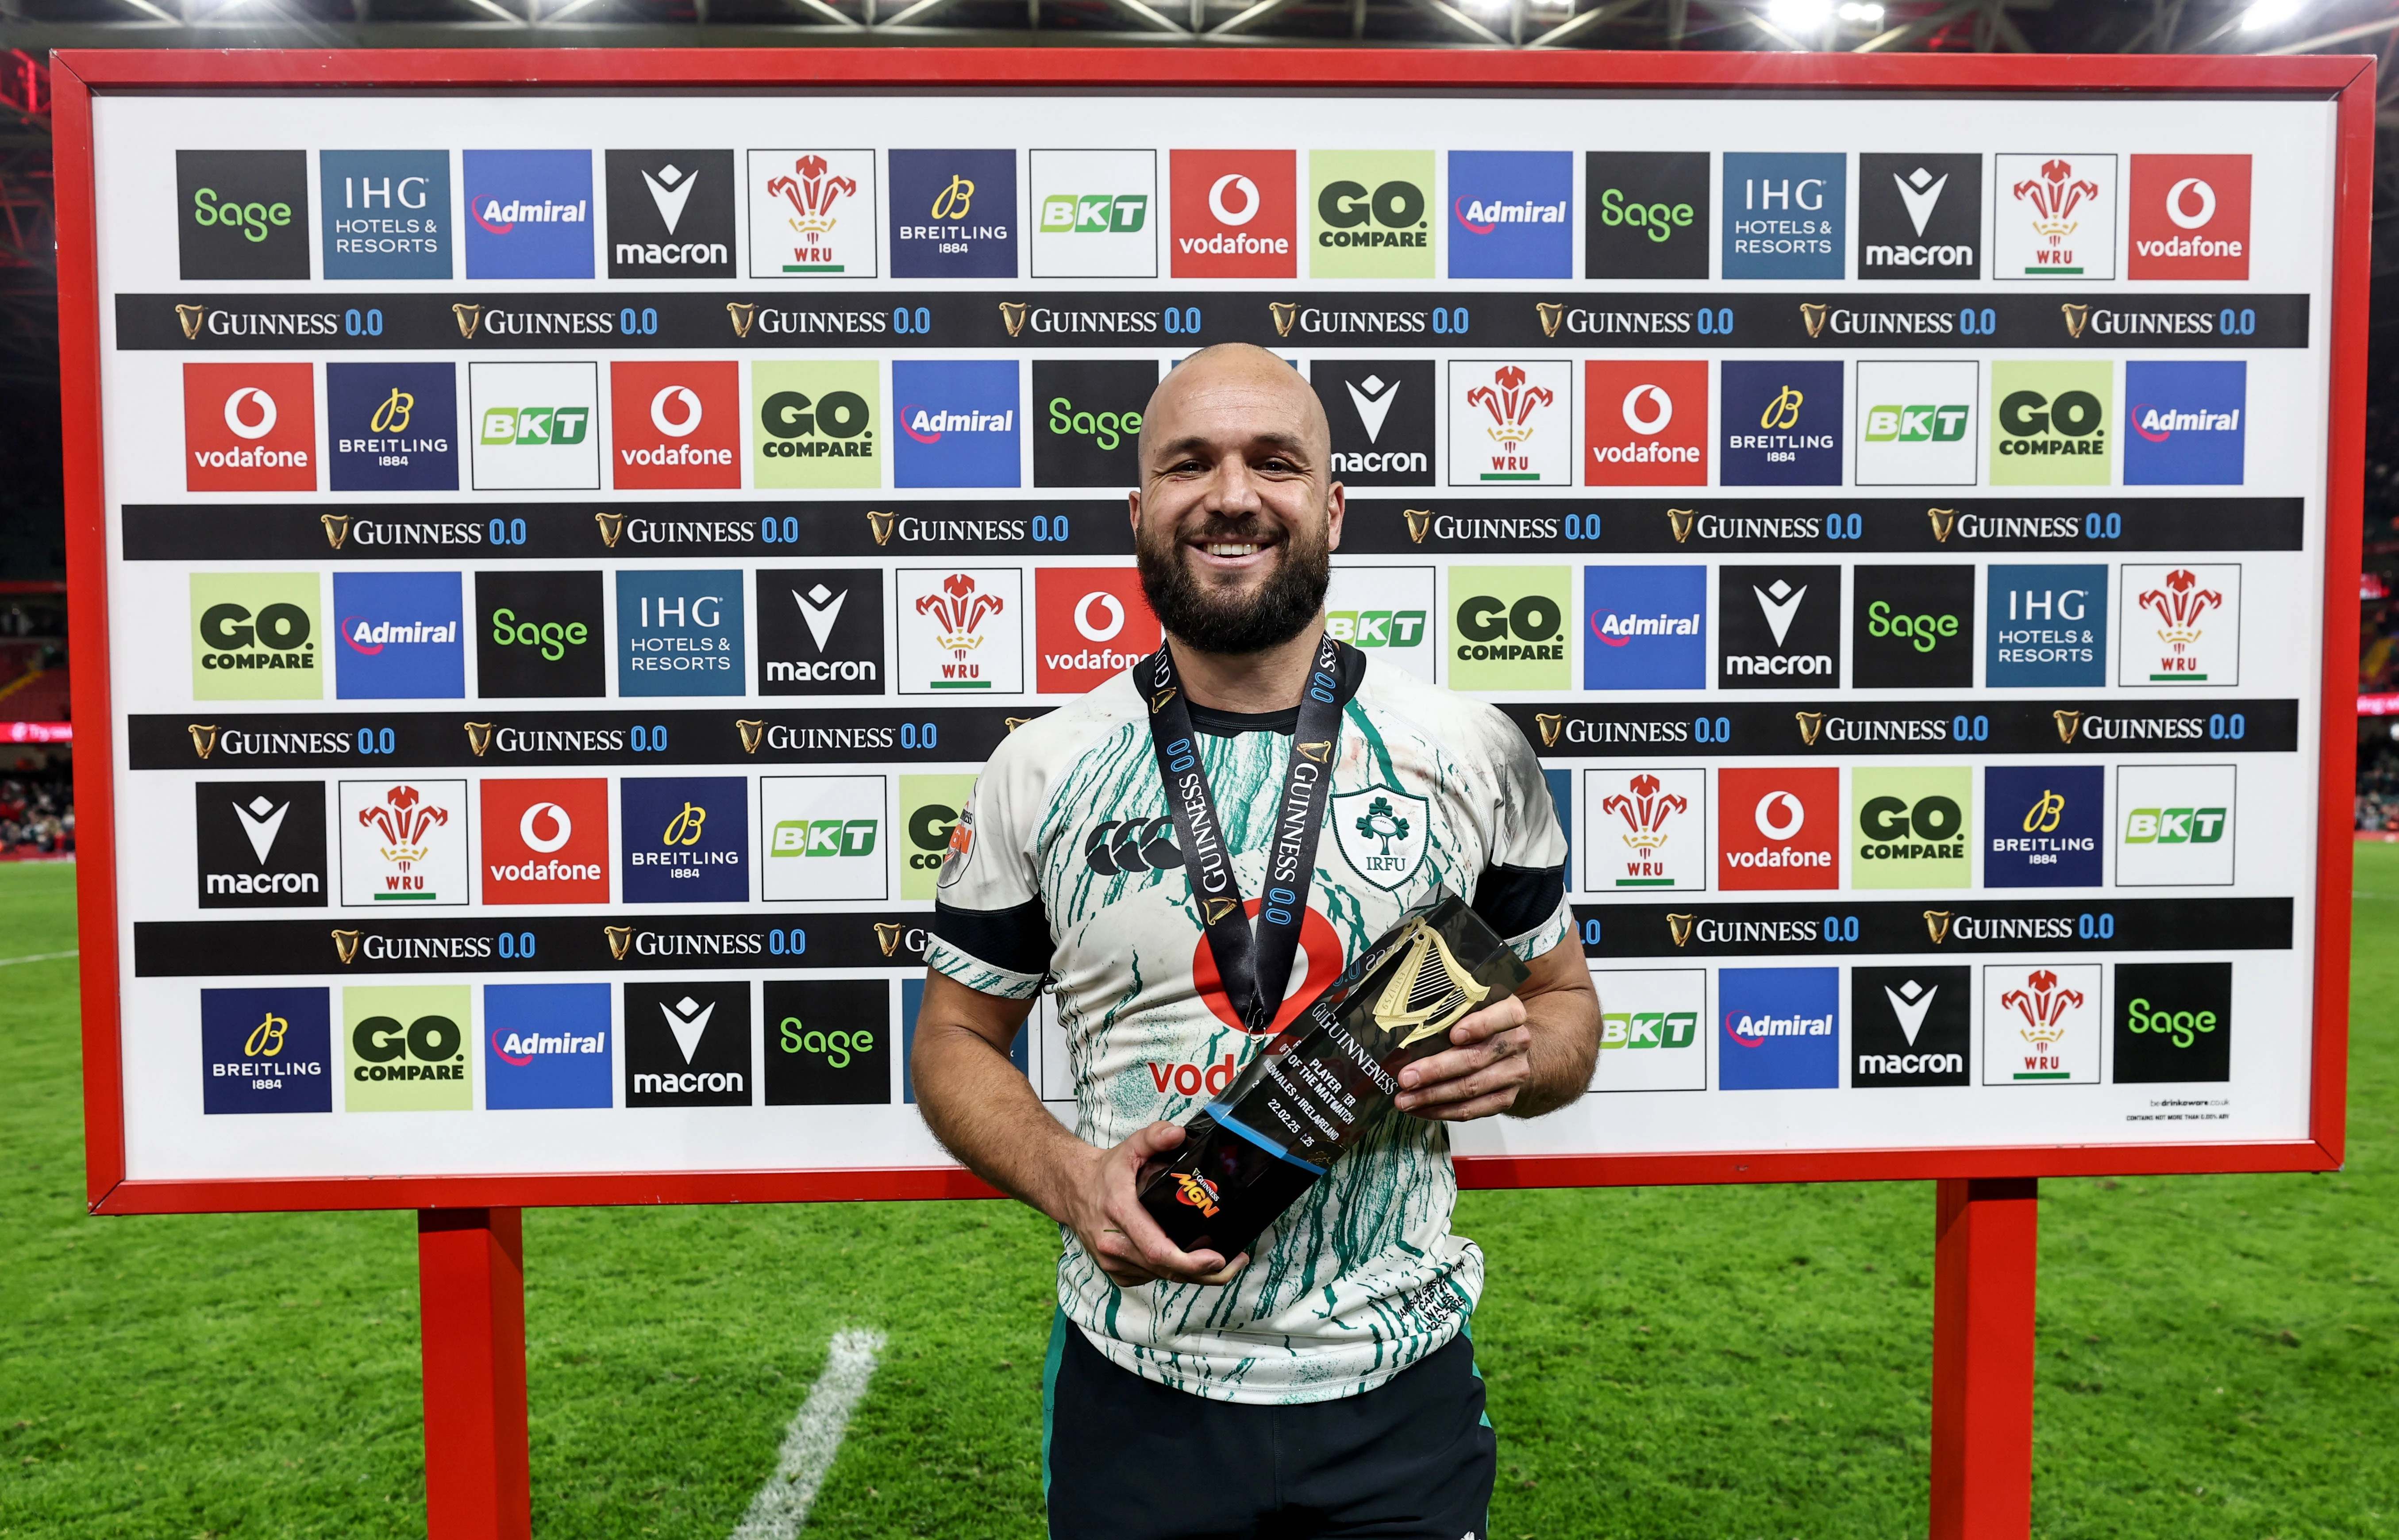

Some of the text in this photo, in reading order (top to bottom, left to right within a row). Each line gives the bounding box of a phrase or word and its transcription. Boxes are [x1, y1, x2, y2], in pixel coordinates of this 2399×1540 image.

[345, 176, 427, 210] IHG
[1745, 178, 1823, 211] IHG
[194, 187, 292, 243] Sage
[482, 199, 587, 223] Admiral
[1041, 200, 1146, 228] BKT
[1465, 200, 1567, 224] Admiral
[1601, 188, 1695, 243] Sage
[335, 218, 438, 234] HOTELS &
[899, 225, 1008, 240] BREITLING
[1735, 219, 1833, 235] HOTELS &
[336, 238, 438, 253] RESORTS
[938, 242, 969, 254] 1884
[1178, 232, 1290, 255] vodafone
[1318, 230, 1428, 248] COMPARE
[1735, 239, 1832, 254] RESORTS
[2136, 234, 2243, 258] vodafone
[615, 242, 728, 265] macron
[794, 247, 832, 263] WRU
[1865, 244, 1974, 266] macron
[2037, 250, 2073, 265] WRU
[207, 307, 384, 337] GUINNESS 0.0
[484, 307, 658, 336] GUINNESS 0.0
[1030, 306, 1202, 334] GUINNESS 0.0
[1299, 306, 1470, 335] GUINNESS 0.0
[1829, 307, 1997, 336] GUINNESS 0.0
[2091, 307, 2257, 336] GUINNESS 0.0
[482, 412, 587, 440] BKT
[1048, 396, 1144, 452] Sage
[1866, 410, 1968, 437] BKT
[2140, 408, 2241, 432] Admiral
[339, 438, 448, 453] BREITLING
[762, 441, 873, 458] COMPARE
[1592, 441, 1701, 463] vodafone
[1729, 434, 1834, 449] BREITLING
[1998, 439, 2104, 456] COMPARE
[194, 445, 308, 468] vodafone
[378, 455, 409, 467] 1884
[620, 443, 733, 466] vodafone
[1491, 456, 1529, 471] WRU
[1766, 451, 1796, 463] 1884
[352, 517, 527, 546] GUINNESS 0.0
[897, 515, 1070, 543] GUINNESS 0.0
[1433, 513, 1602, 541] GUINNESS 0.0
[1696, 512, 1863, 540] GUINNESS 0.0
[1956, 511, 2122, 540] GUINNESS 0.0
[640, 595, 720, 628] IHG
[2009, 589, 2085, 621] IHG
[352, 620, 457, 644] Admiral
[1325, 616, 1424, 642] BKT
[1601, 613, 1701, 636] Admiral
[1868, 600, 1960, 653] Sage
[1999, 629, 2094, 644] HOTELS &
[631, 637, 731, 652] HOTELS &
[1456, 643, 1564, 662] COMPARE
[1998, 648, 2094, 663] RESORTS
[201, 653, 315, 670] COMPARE
[631, 656, 731, 671] RESORTS
[1726, 654, 1833, 676] macron
[2160, 657, 2198, 672] WRU
[495, 724, 668, 753] GUINNESS 0.0
[766, 722, 938, 750] GUINNESS 0.0
[1565, 716, 1731, 744] GUINNESS 0.0
[2082, 713, 2246, 741] GUINNESS 0.0
[220, 726, 396, 755] GUINNESS 0.0
[1178, 773, 1228, 893] GUINNESS
[2126, 812, 2225, 839] BKT
[1265, 762, 1319, 925] GUINNESS 0.0
[1859, 842, 1965, 861] COMPARE
[1993, 837, 2095, 852] BREITLING
[632, 851, 739, 866] BREITLING
[1366, 856, 1406, 872] IRFU
[1725, 845, 1832, 868] vodafone
[2027, 853, 2058, 866] 1884
[670, 868, 701, 879] 1884
[1627, 861, 1664, 877] WRU
[206, 872, 320, 895] macron
[385, 875, 424, 891] WRU
[1695, 915, 1860, 943] GUINNESS 0.0
[1952, 912, 2115, 940] GUINNESS 0.0
[362, 931, 536, 960] GUINNESS 0.0
[635, 928, 806, 956] GUINNESS 0.0
[1602, 1017, 1695, 1044] BKT
[1735, 1014, 1833, 1037] Admiral
[2128, 997, 2217, 1049] Sage
[502, 1031, 606, 1055] Admiral
[779, 1016, 874, 1069] Sage
[212, 1061, 322, 1077] BREITLING
[353, 1064, 465, 1082] COMPARE
[1288, 1054, 1303, 1068] OF
[1299, 1065, 1318, 1087] THE
[1858, 1053, 1964, 1075] macron
[2024, 1056, 2060, 1070] WRU
[251, 1079, 283, 1090] 1884
[633, 1072, 744, 1094] macron
[1309, 1058, 1343, 1095] PLAYER
[1267, 1098, 1302, 1134] 22.02.25
[1196, 1175, 1220, 1202] GUINNESS
[1397, 1292, 1423, 1321] JAMISON
[1418, 1291, 1435, 1311] CAP
[1424, 1293, 1454, 1321] WALES
